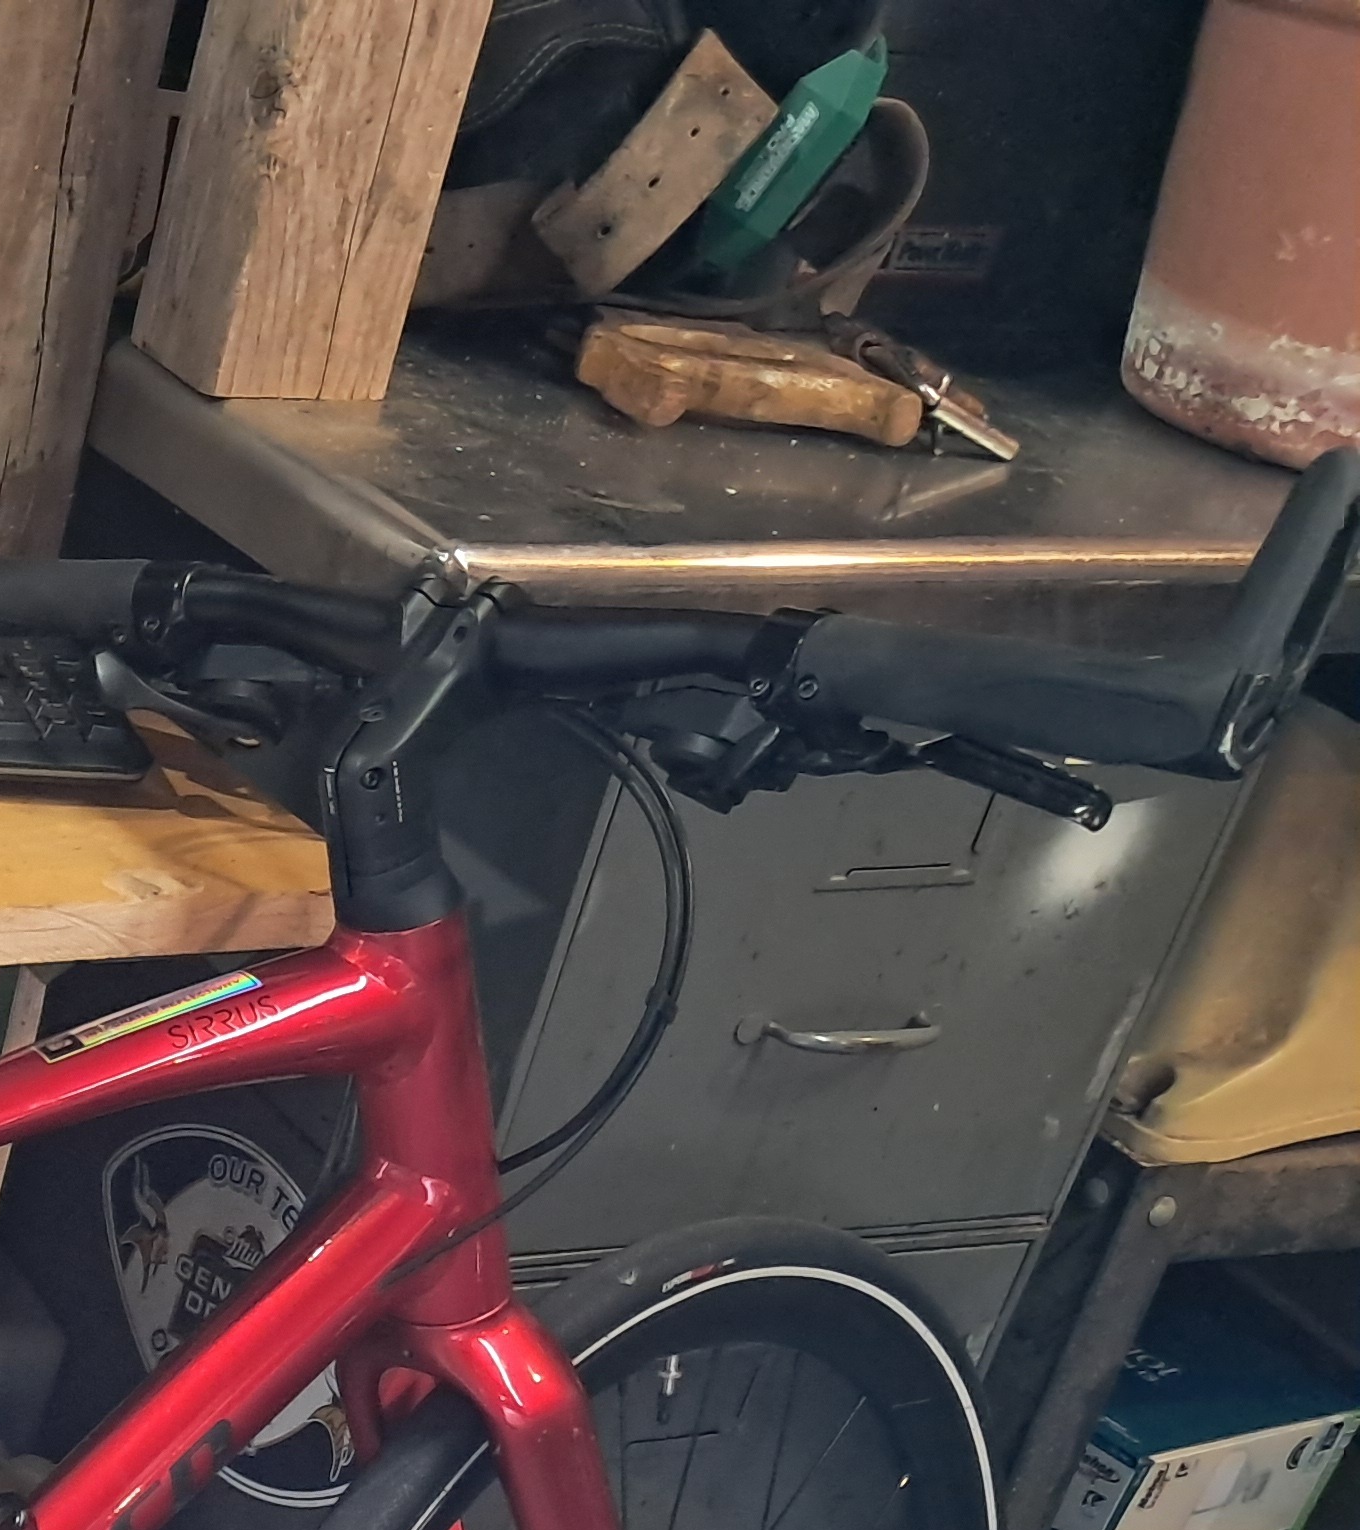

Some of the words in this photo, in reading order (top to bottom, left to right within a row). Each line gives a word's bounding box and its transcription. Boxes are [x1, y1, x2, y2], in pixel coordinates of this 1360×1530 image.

[167, 993, 279, 1051] SIRRUS
[208, 1154, 264, 1194] OUR
[176, 1255, 232, 1301] GEN
